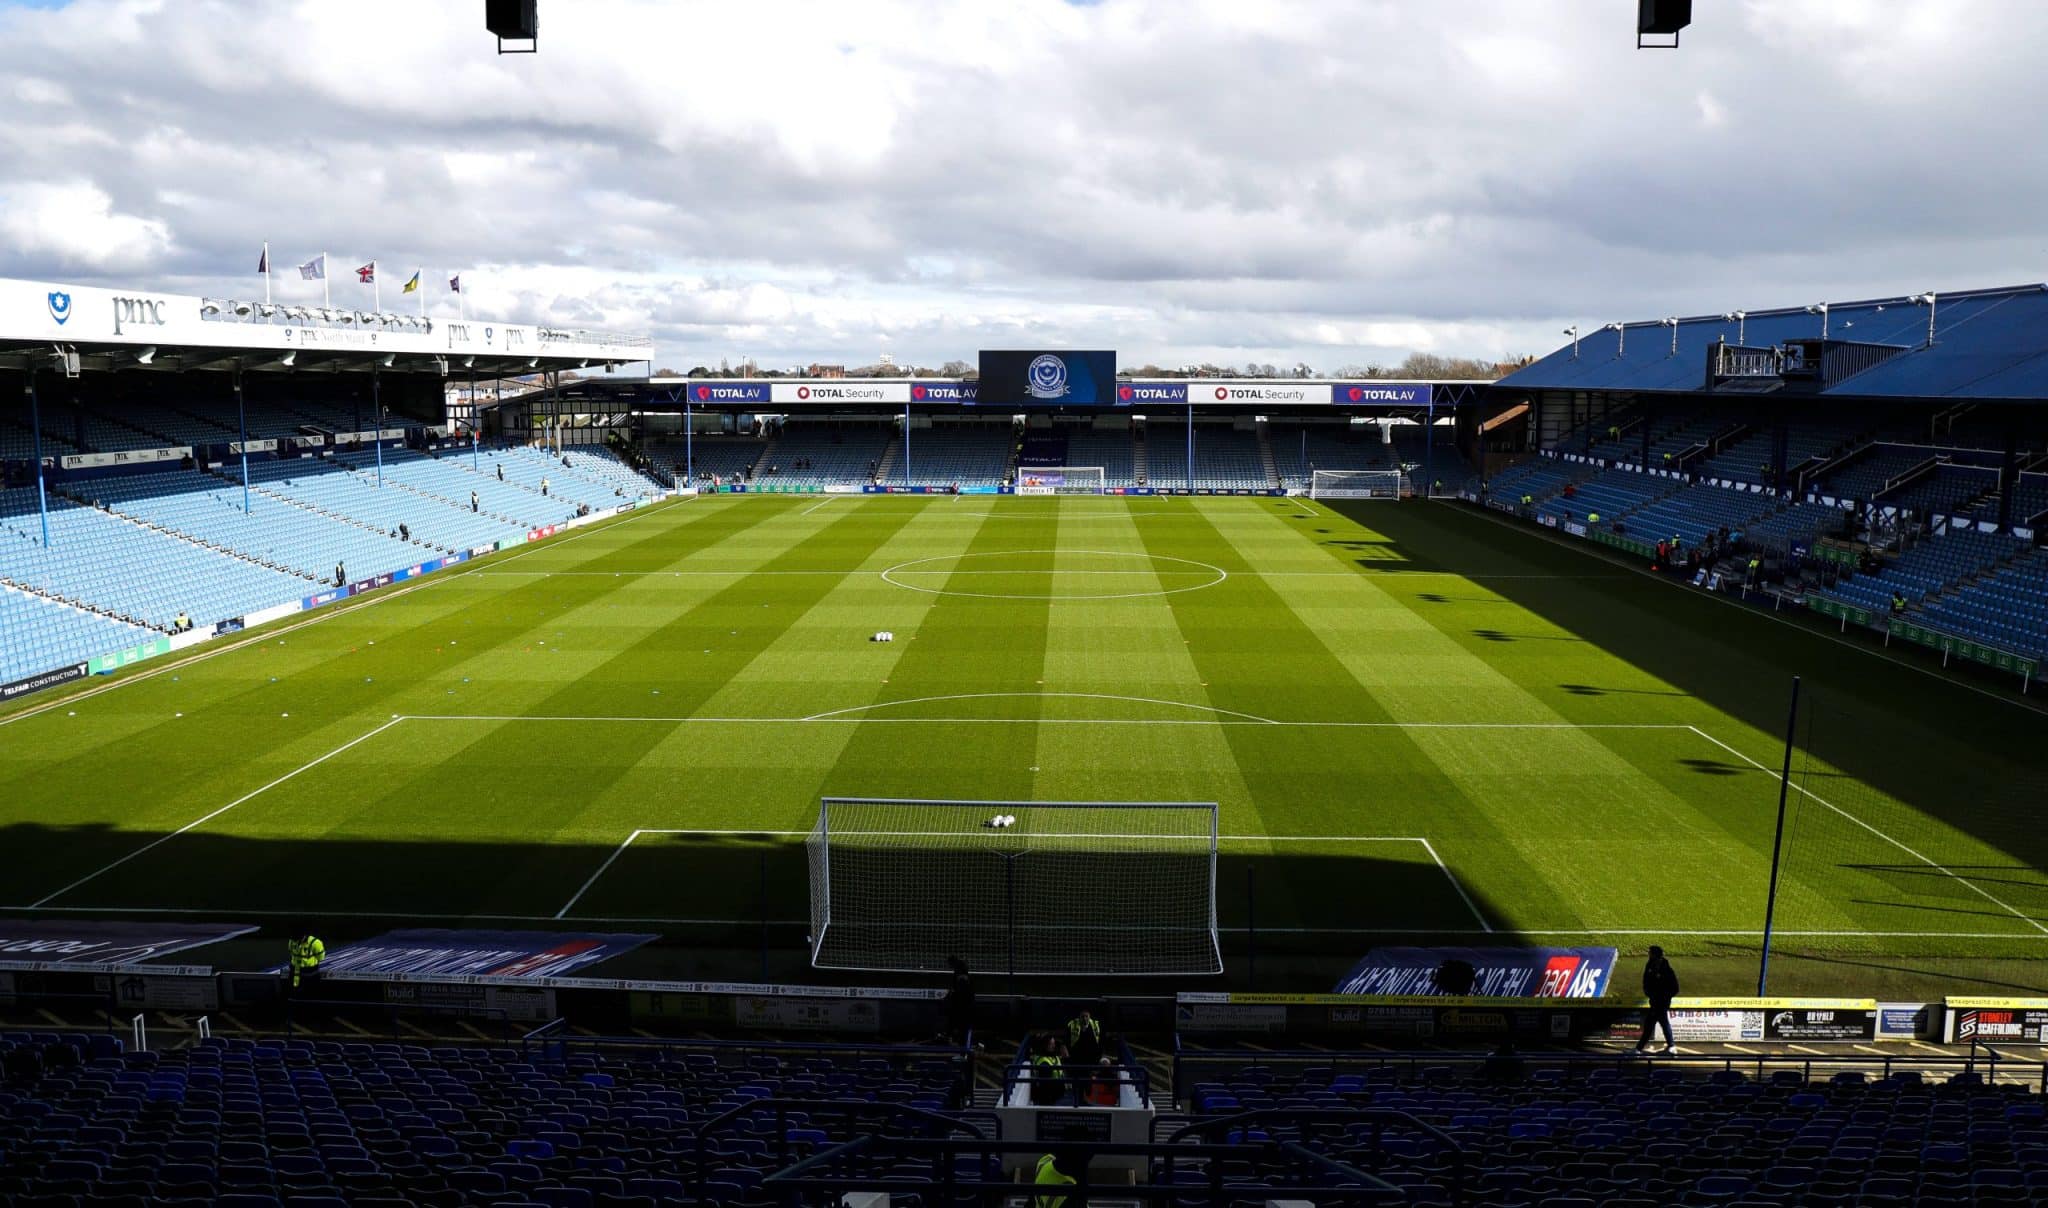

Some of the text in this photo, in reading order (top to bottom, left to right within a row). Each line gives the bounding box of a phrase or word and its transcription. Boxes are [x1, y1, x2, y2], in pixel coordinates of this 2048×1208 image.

[113, 296, 166, 336] pmc
[712, 388, 760, 398] TOTAL AV
[812, 388, 885, 400] TOTAL Security
[928, 389, 978, 398] TOTAL AV
[1134, 389, 1185, 399] TOTAL AV
[1230, 389, 1305, 401] TOTAL Security
[1363, 390, 1415, 400] TOTAL AV
[4, 669, 79, 696] TELFAIR CONSTRUCTION
[1977, 1023, 2023, 1035] SCAFFOLDING
